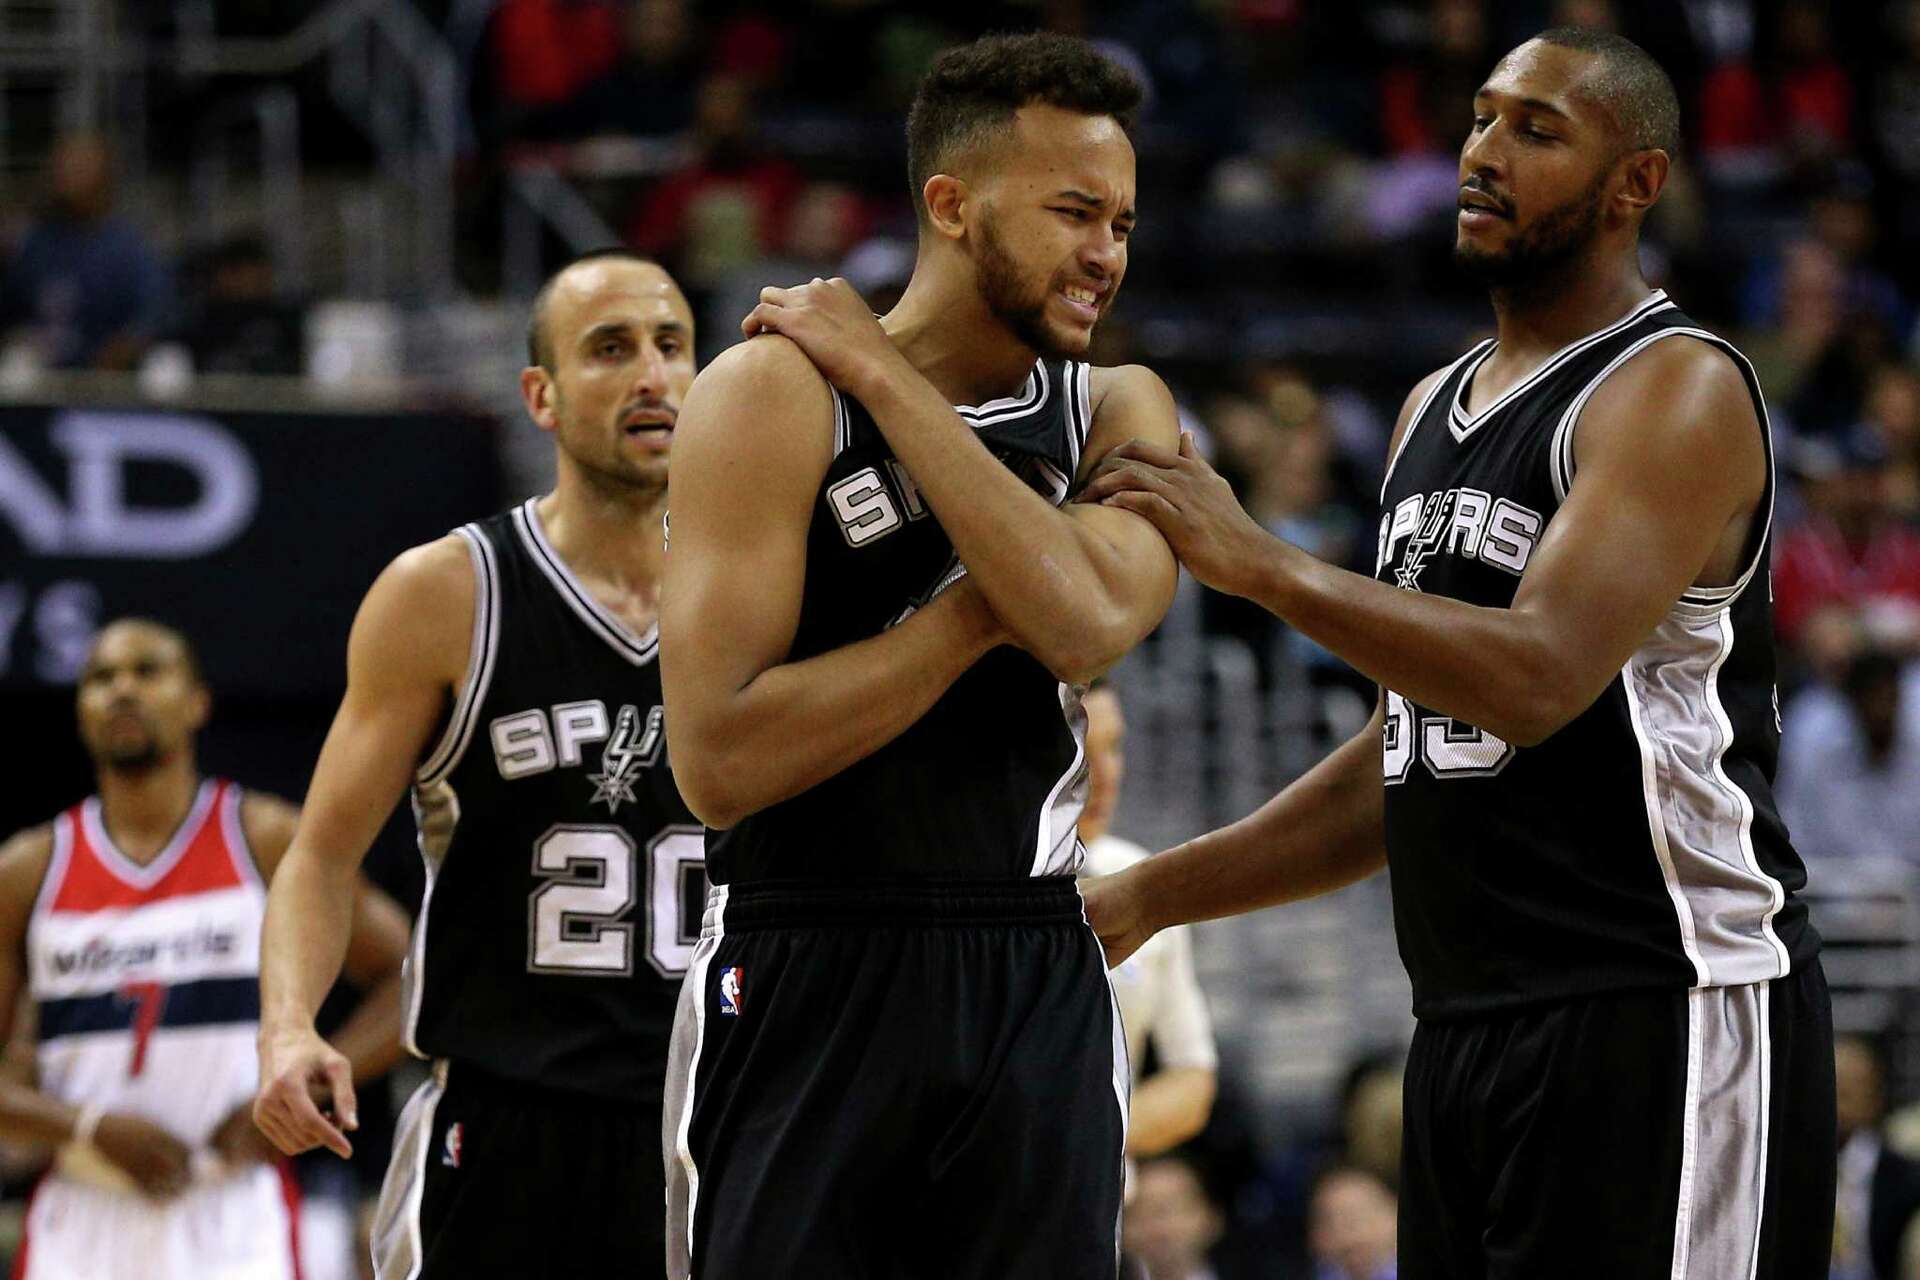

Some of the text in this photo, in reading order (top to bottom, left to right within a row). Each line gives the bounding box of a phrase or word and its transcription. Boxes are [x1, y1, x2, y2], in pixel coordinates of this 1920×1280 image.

[1377, 486, 1544, 592] PURS
[489, 698, 670, 815] SPU
[527, 822, 706, 980] 20
[117, 977, 168, 1078] 7
